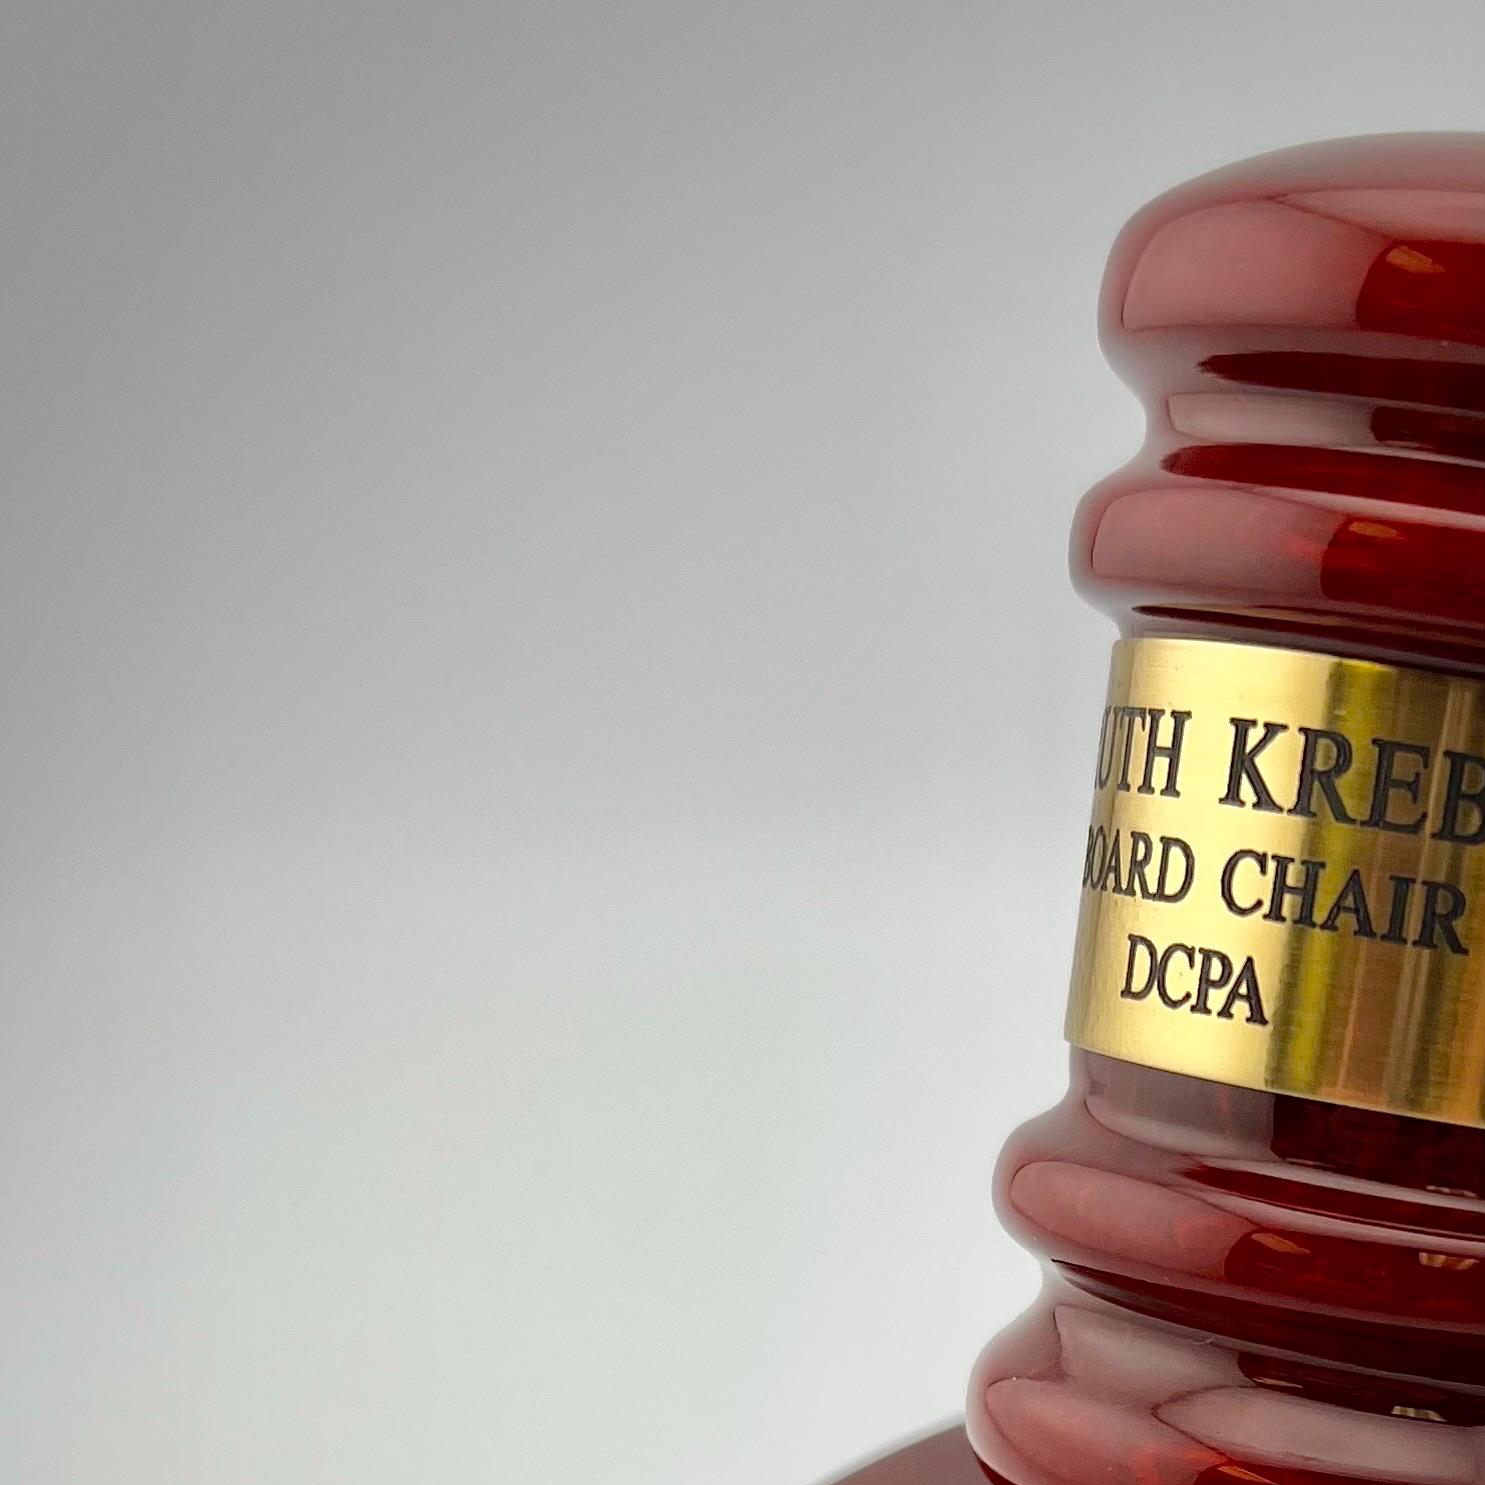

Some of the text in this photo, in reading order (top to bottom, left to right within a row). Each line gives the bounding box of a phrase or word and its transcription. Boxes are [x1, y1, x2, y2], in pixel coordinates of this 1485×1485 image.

[1095, 706, 1192, 798] UTH
[1220, 849, 1469, 956] CHAIR
[1120, 933, 1269, 1026] DCPA
